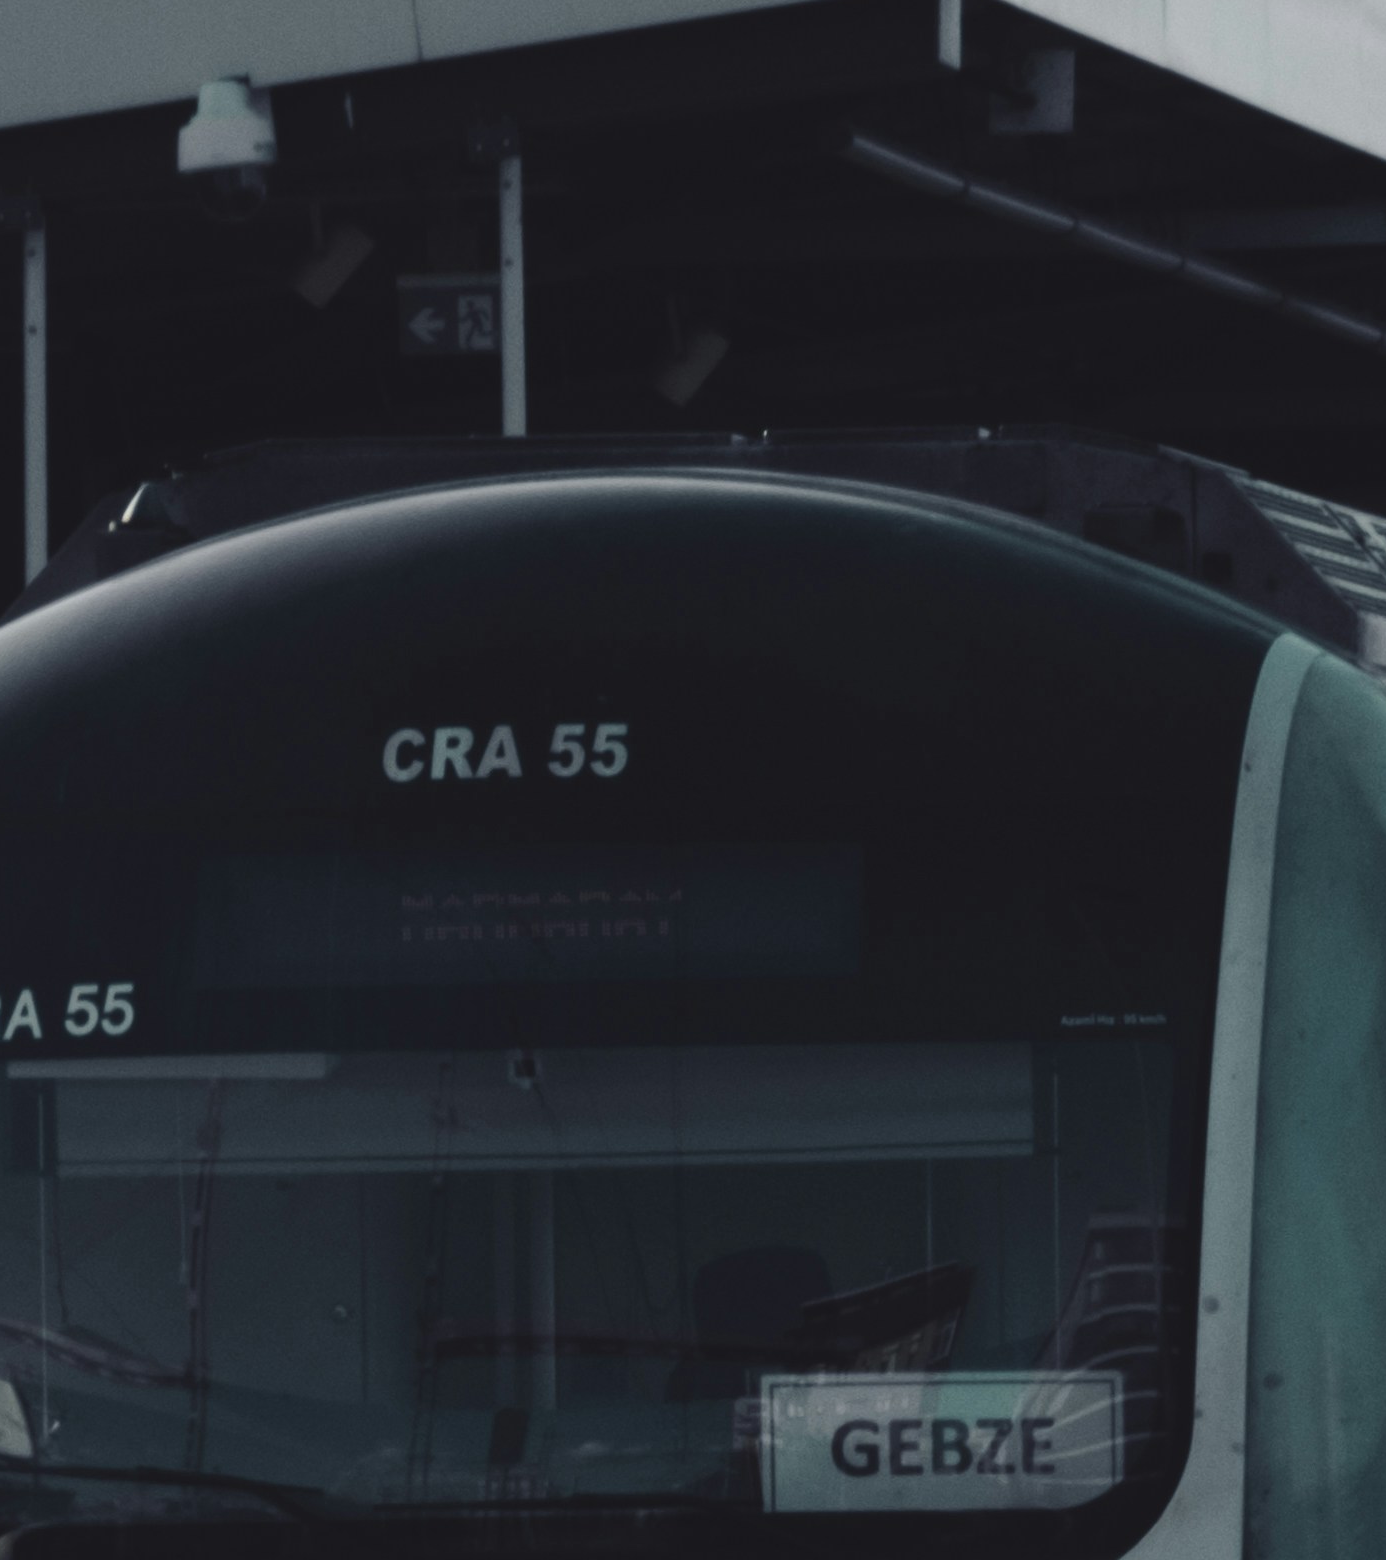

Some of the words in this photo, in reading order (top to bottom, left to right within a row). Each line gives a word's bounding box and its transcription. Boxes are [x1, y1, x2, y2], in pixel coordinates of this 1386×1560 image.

[382, 724, 523, 783] CRA
[547, 722, 629, 778] 55
[63, 982, 135, 1037] 55
[830, 1417, 1056, 1478] GEBZE
